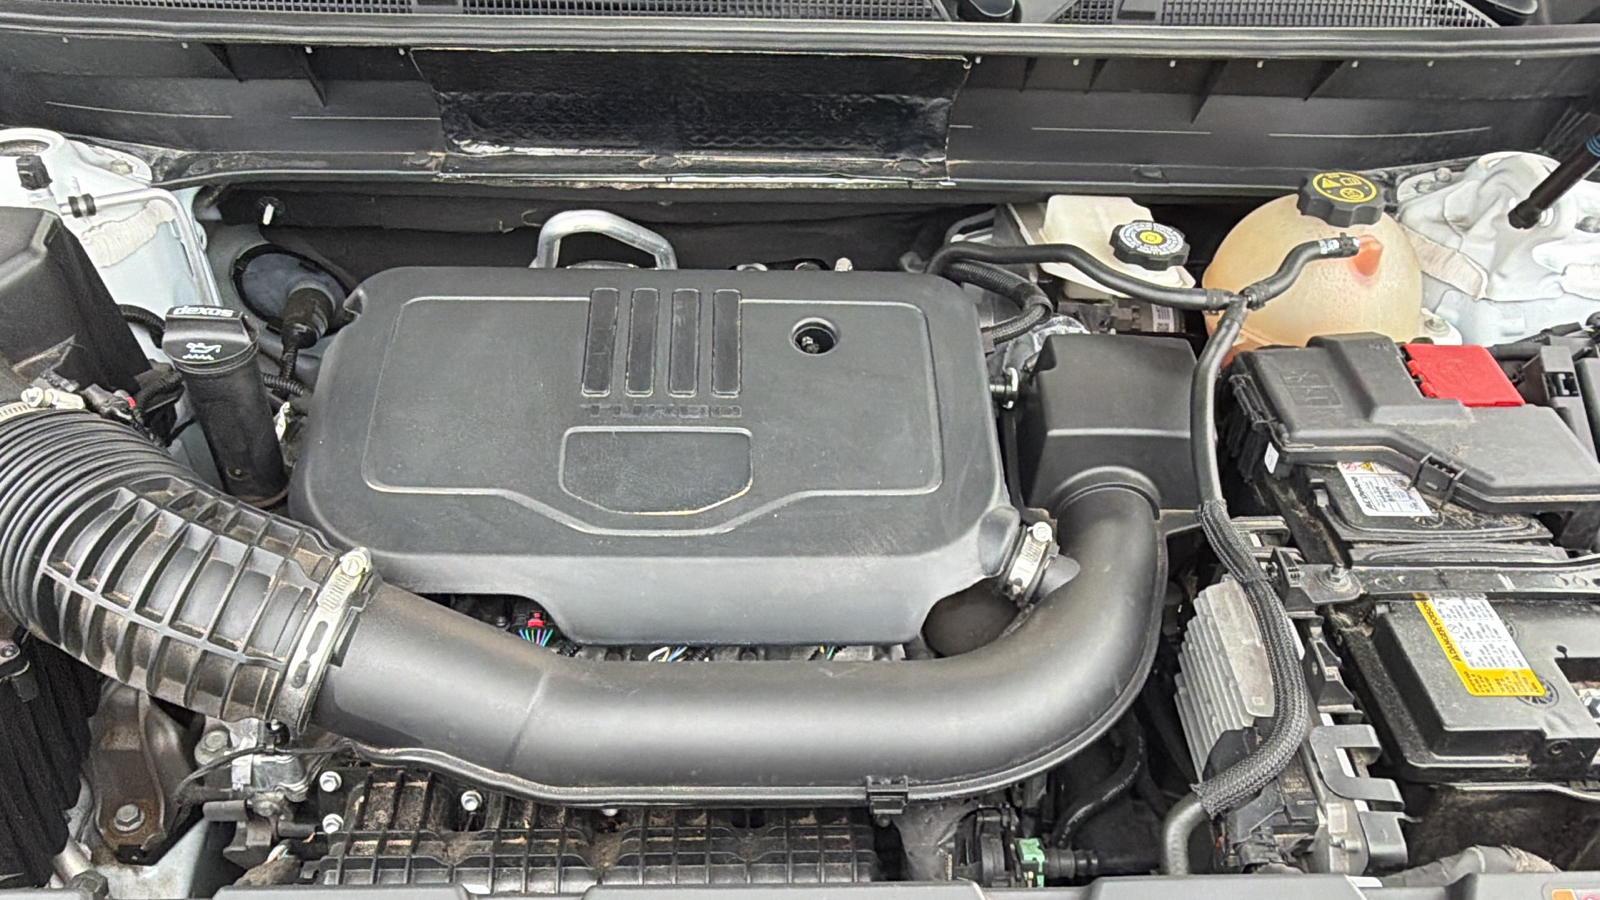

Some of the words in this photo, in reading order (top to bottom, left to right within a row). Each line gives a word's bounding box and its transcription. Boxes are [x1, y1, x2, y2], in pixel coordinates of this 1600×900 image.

[172, 305, 234, 318] dexos
[579, 403, 743, 419] TURBO
[1421, 601, 1440, 626] POISON
[1437, 626, 1457, 654] DANGER
